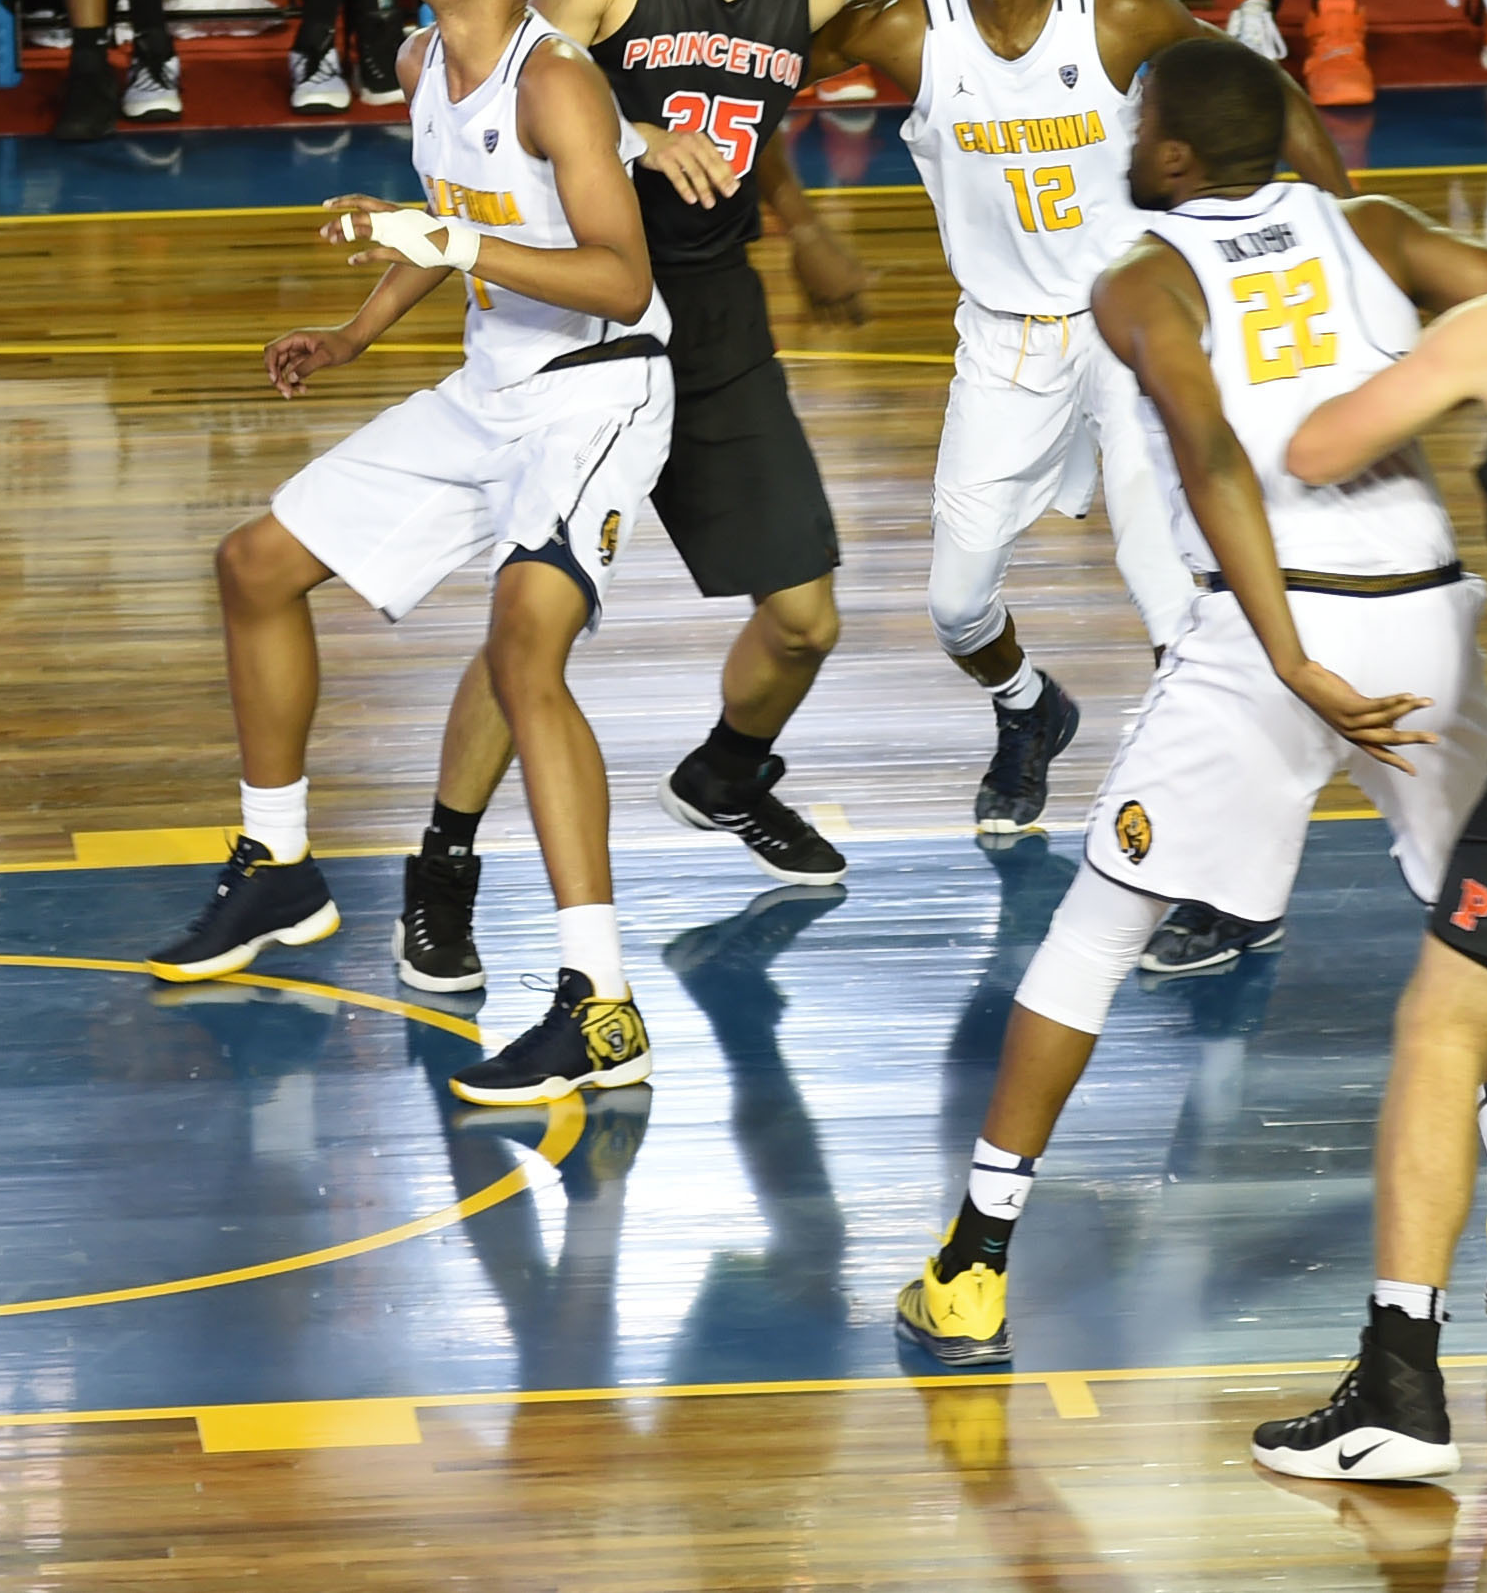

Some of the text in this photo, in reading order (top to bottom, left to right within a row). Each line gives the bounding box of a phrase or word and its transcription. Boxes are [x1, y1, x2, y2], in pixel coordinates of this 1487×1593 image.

[622, 30, 803, 89] PRINCETON
[952, 109, 1107, 155] CALIFORNIA
[1003, 164, 1084, 234] 12
[1230, 257, 1340, 386] 22
